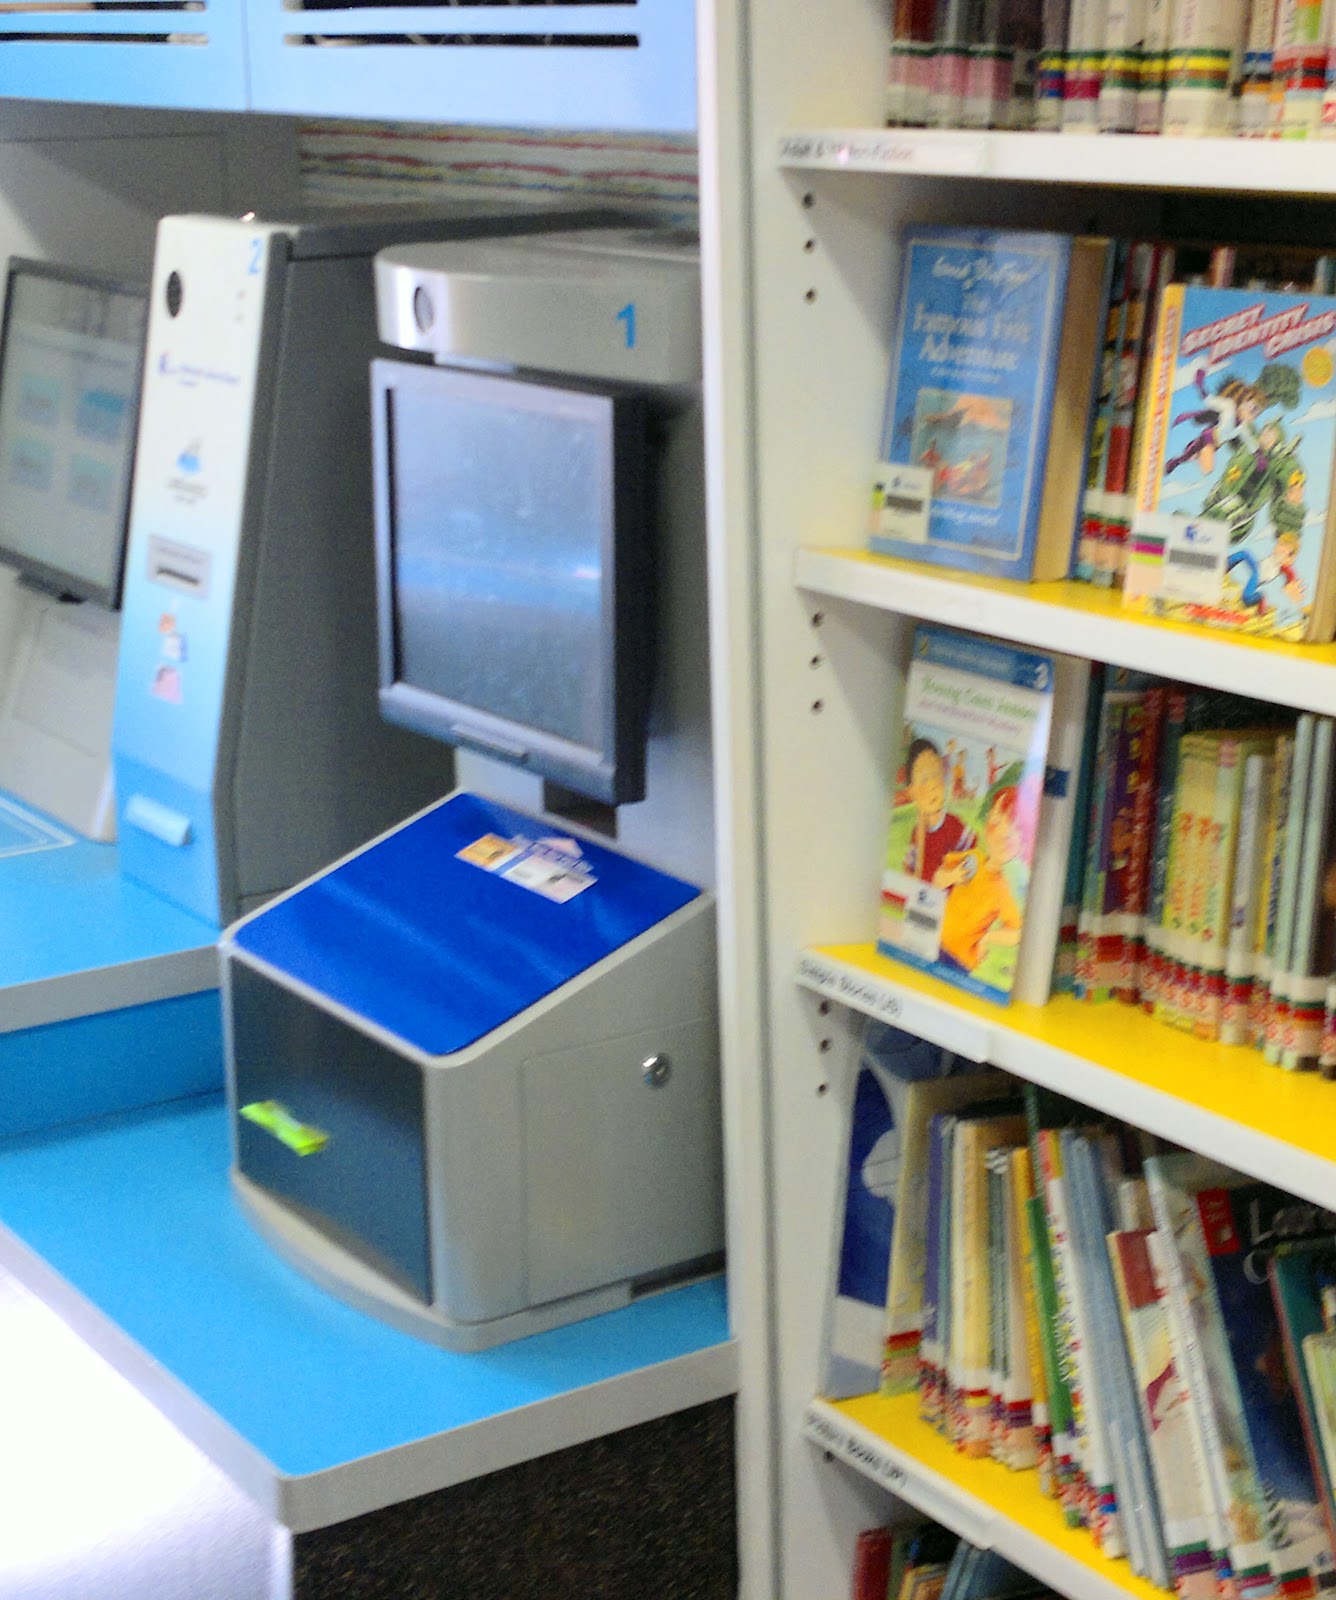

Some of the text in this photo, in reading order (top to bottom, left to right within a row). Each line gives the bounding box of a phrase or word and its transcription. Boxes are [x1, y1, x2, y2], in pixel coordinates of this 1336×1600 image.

[248, 237, 263, 275] 2
[616, 303, 636, 348] 1
[1181, 302, 1266, 357] SECRET
[1208, 302, 1310, 366] IDENTITY
[1033, 662, 1049, 690] 3
